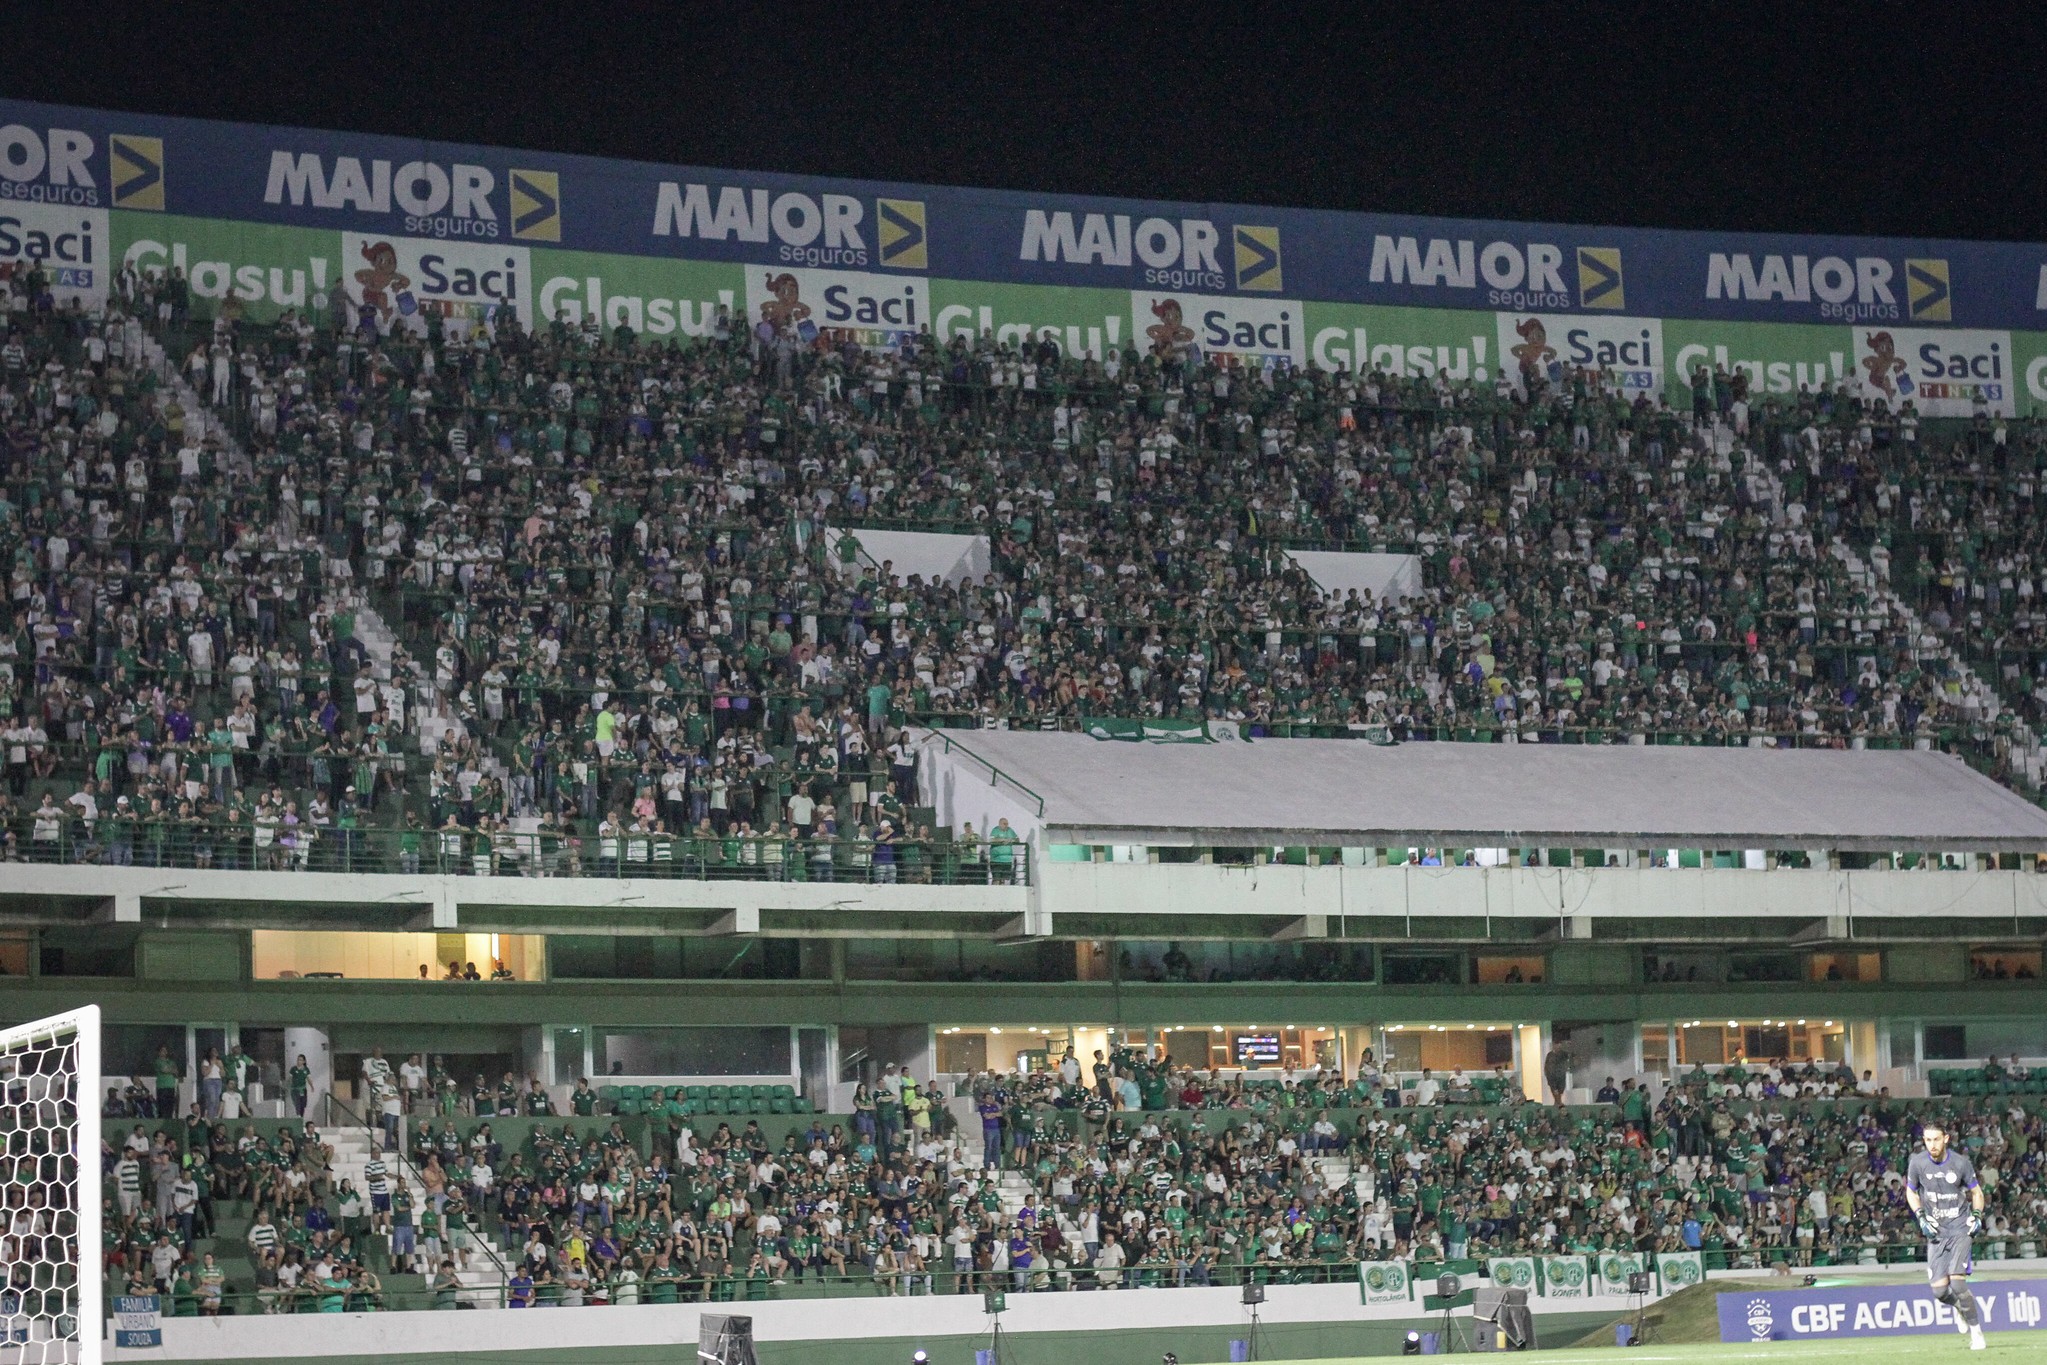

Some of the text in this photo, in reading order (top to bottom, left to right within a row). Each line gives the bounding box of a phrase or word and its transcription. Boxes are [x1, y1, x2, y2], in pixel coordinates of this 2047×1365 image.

[1, 181, 99, 206] seguros
[264, 150, 497, 220] MAIOR
[404, 215, 499, 238] seguros
[651, 181, 867, 250] MAIOR
[779, 245, 868, 267] seguros
[1019, 209, 1224, 274] MAIOR
[419, 254, 516, 299] Saci
[1145, 268, 1226, 290] seguros
[1369, 235, 1568, 293] MAIOR
[1705, 253, 1896, 304] MAIOR
[420, 301, 511, 320] TINT
[824, 284, 915, 326] Saci
[1488, 290, 1570, 311] seguros
[1820, 302, 1900, 323] seguros
[827, 327, 913, 346] TINTA
[1203, 310, 1291, 350] Saci
[1567, 328, 1651, 367] Saci
[1209, 353, 1289, 371] TITAS
[1312, 326, 1489, 383] Glasu!
[1919, 342, 2002, 379] Saci
[1791, 1295, 1997, 1333] CBF ACADEY
[2007, 1291, 2042, 1327] idp
